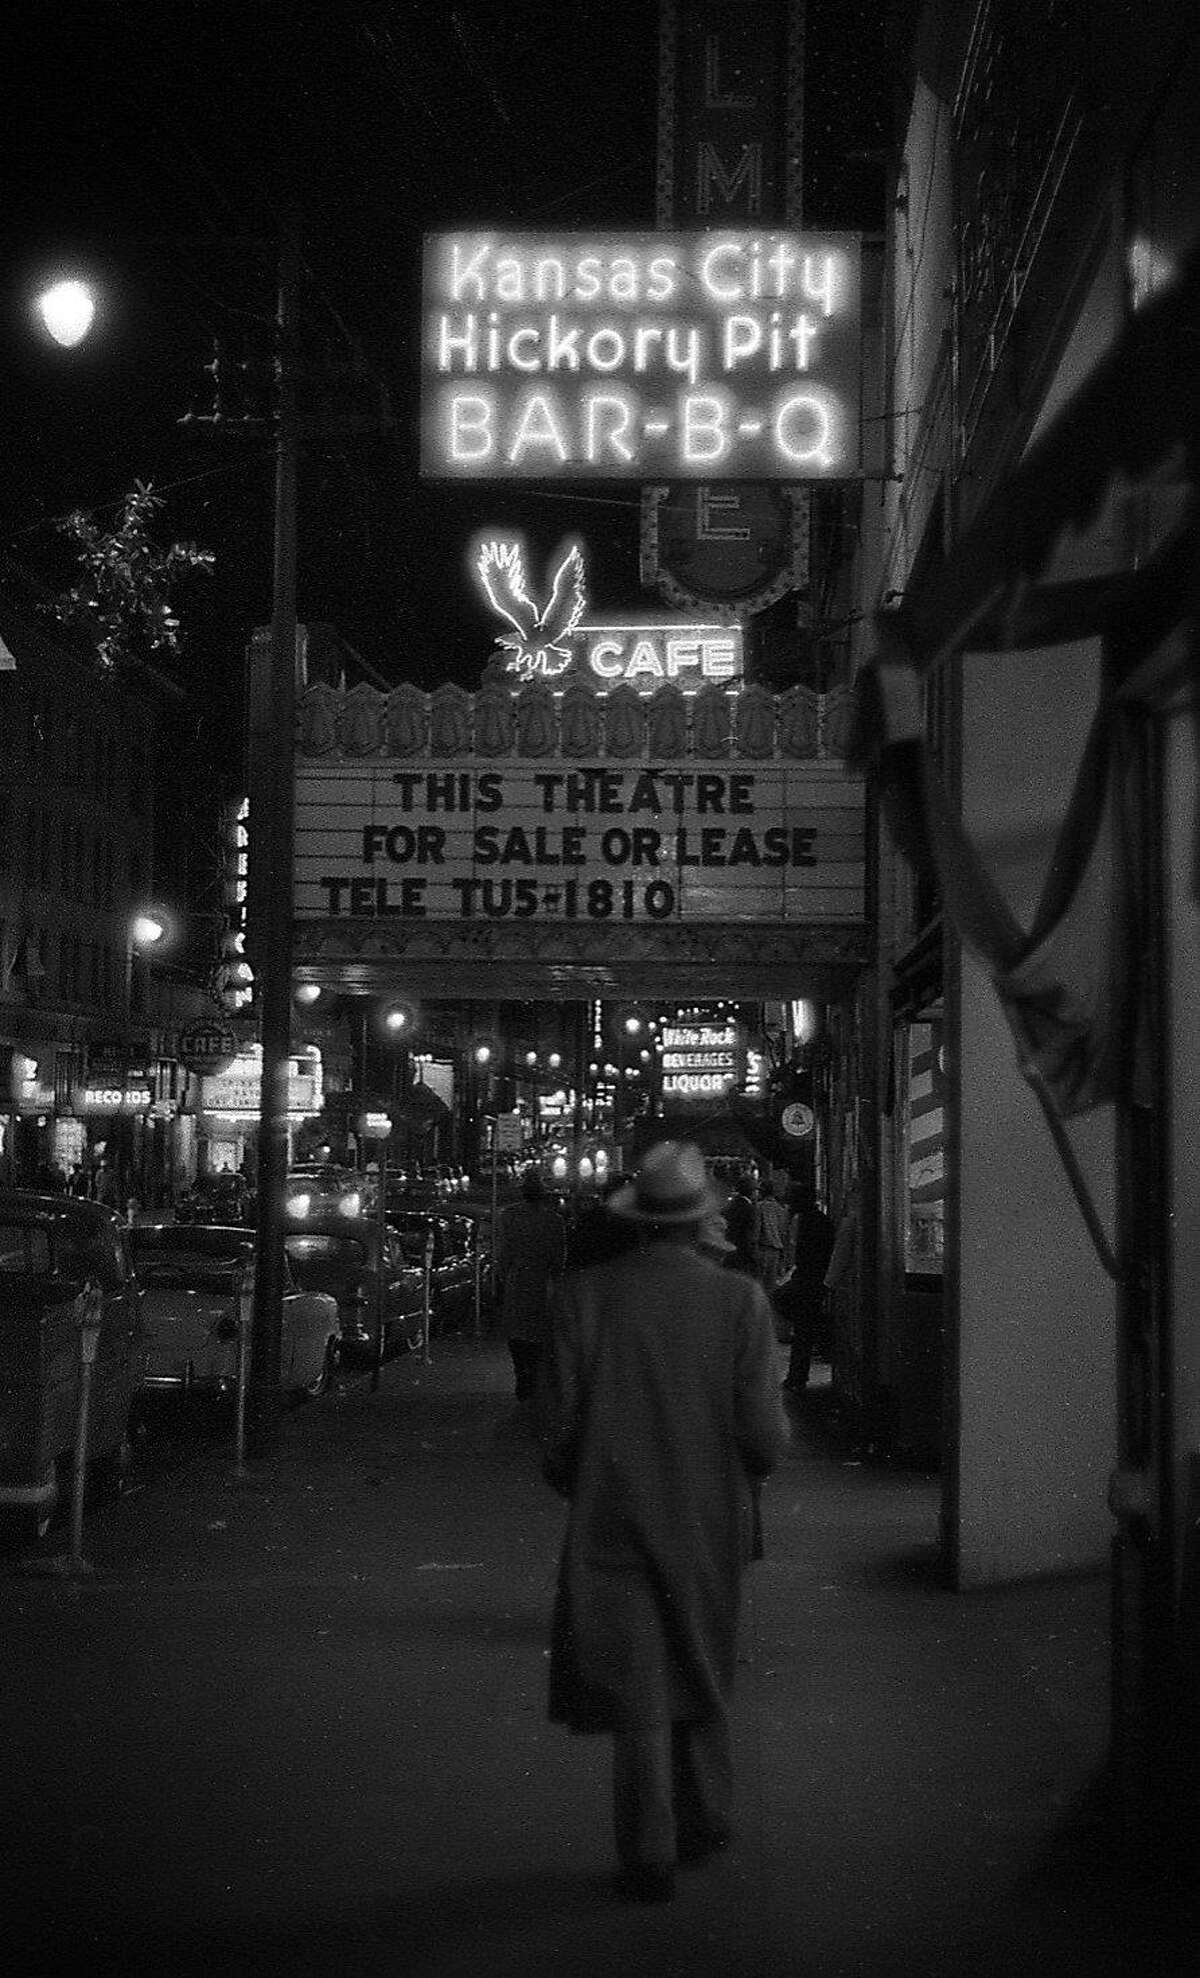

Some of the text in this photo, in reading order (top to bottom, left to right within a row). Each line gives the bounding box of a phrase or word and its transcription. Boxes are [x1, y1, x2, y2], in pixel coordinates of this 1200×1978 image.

[450, 241, 838, 317] Kansas City
[438, 311, 818, 385] Hickory Pit
[449, 395, 835, 468] BAR-B-Q
[588, 639, 738, 679] CAFE
[394, 768, 756, 814] THIS THEATRE
[362, 824, 818, 867] FOR SALE OR LEASE
[321, 877, 676, 919] TELE TU5-1810
[181, 1035, 233, 1054] CAFE
[662, 1053, 734, 1068] BEVERAGES
